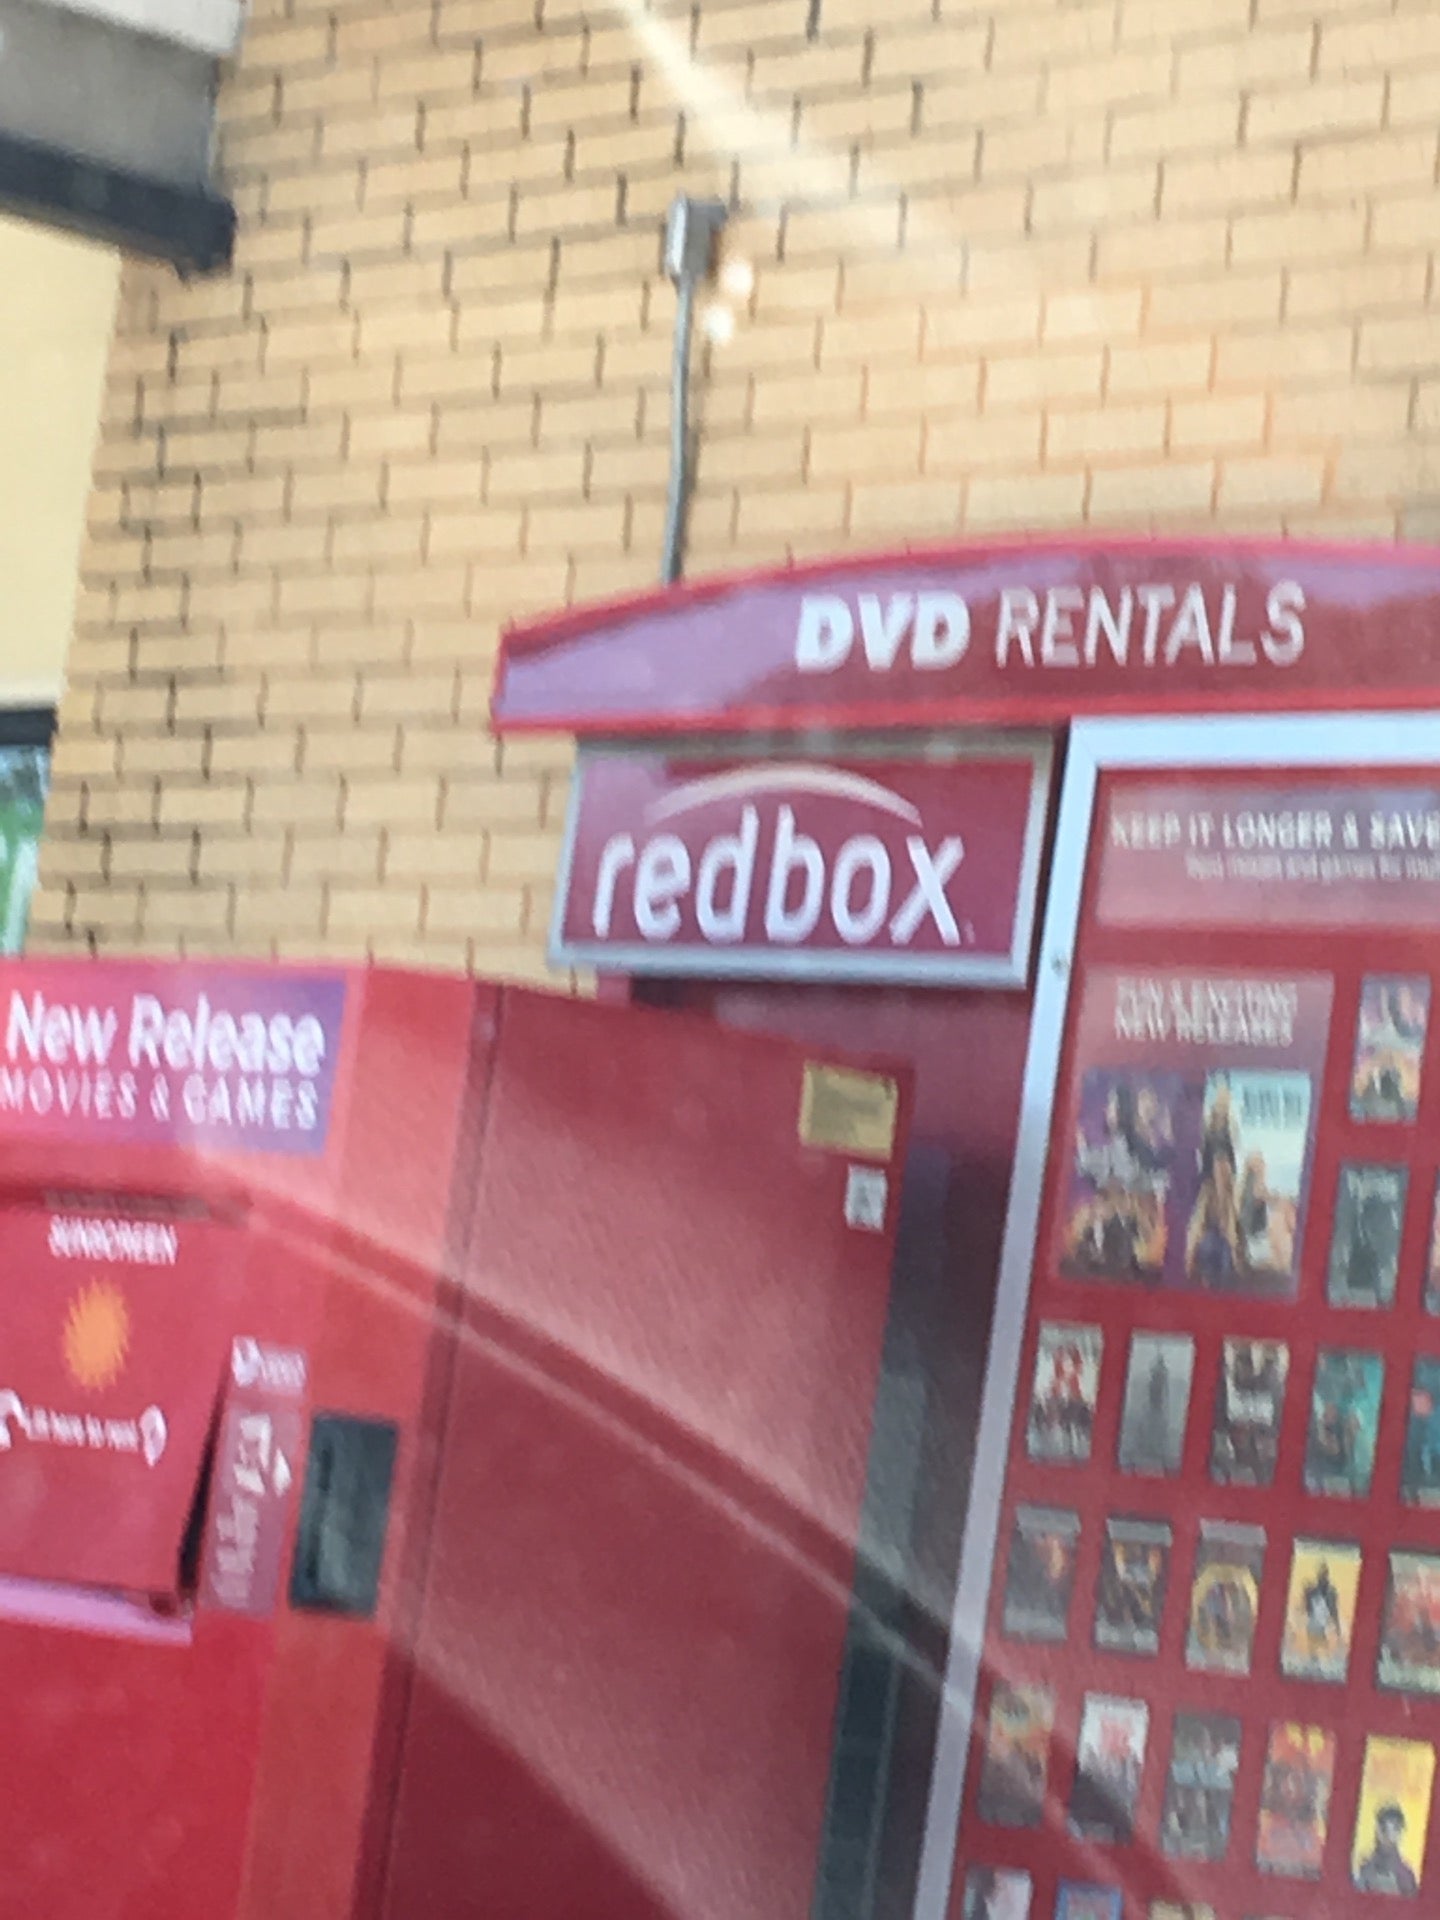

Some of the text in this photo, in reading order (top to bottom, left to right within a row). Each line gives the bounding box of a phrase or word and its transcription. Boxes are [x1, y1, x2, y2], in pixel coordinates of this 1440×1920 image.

[795, 580, 1307, 671] DVD RENTALS
[593, 803, 965, 946] redbox
[1222, 810, 1332, 850] LONGER
[7, 988, 326, 1078] New Release
[0, 1065, 138, 1121] MOVIES
[183, 1073, 319, 1131] GAMES
